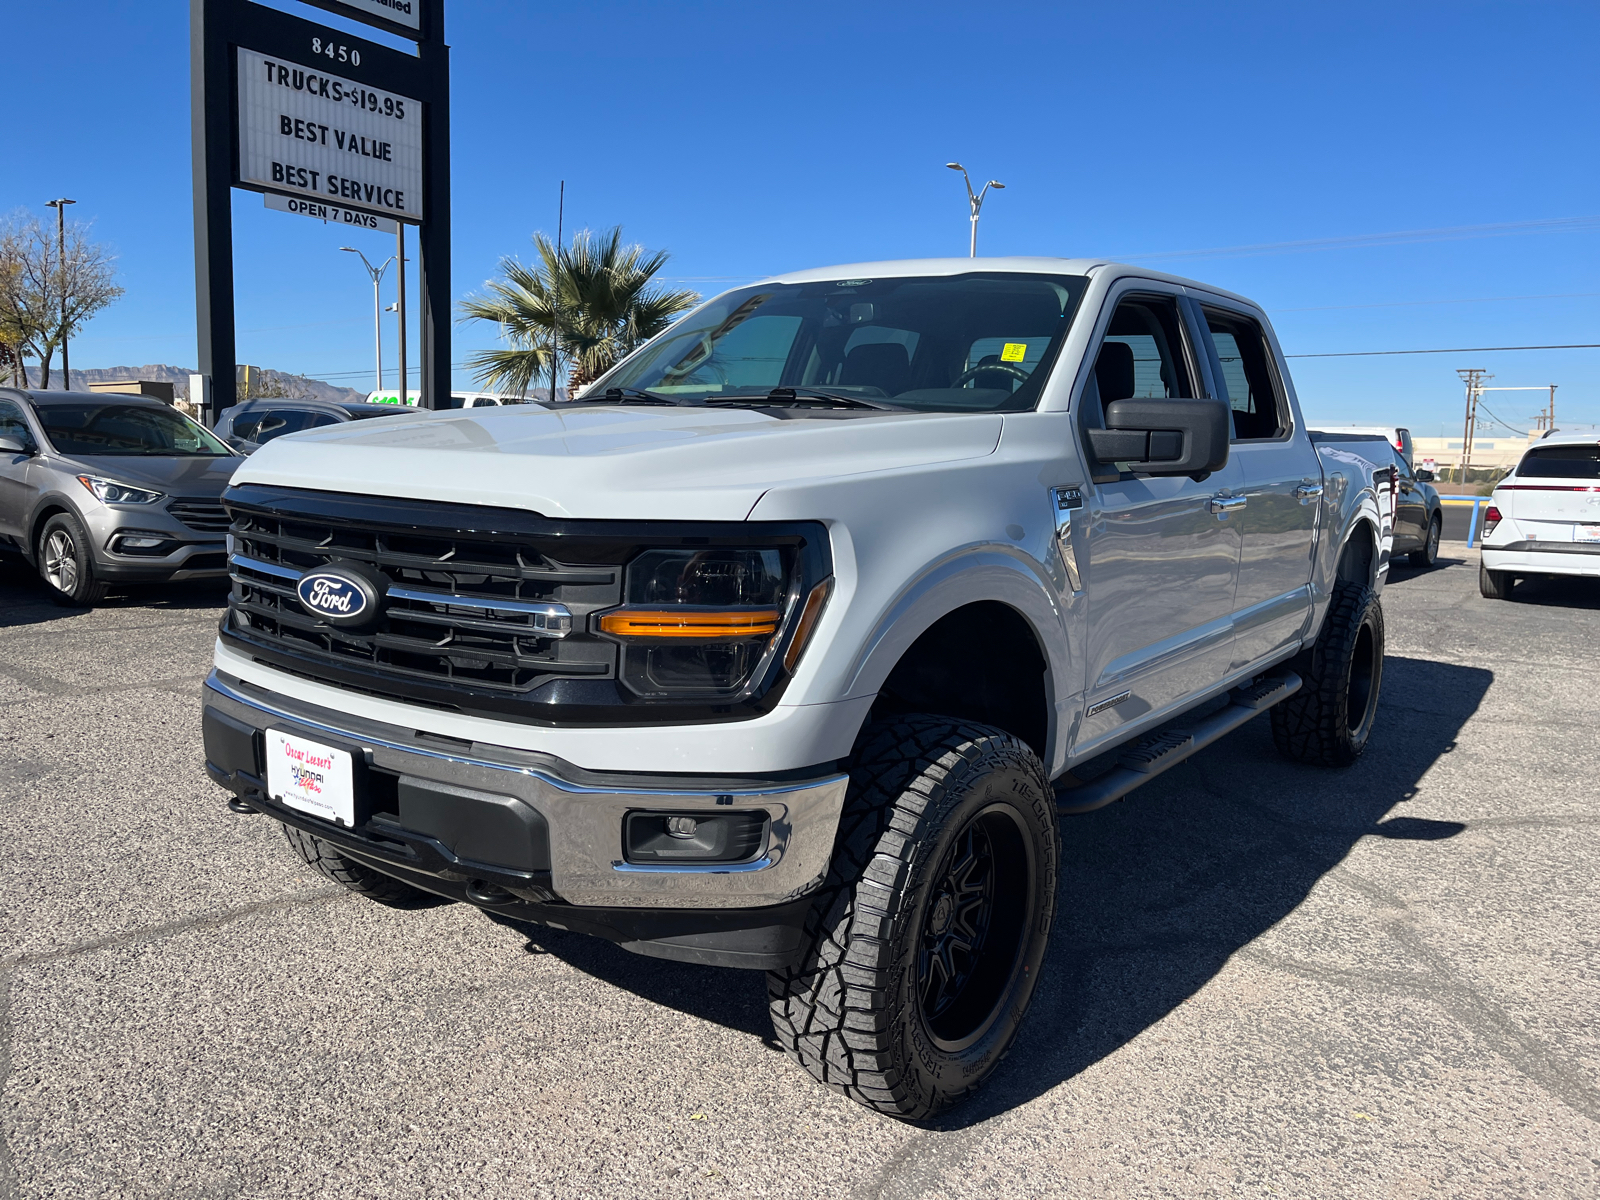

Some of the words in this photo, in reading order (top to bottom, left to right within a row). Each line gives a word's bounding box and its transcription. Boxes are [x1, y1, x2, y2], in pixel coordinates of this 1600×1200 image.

[311, 37, 361, 67] 8450
[263, 60, 405, 120] TRUCKS-$19.95
[280, 114, 329, 146] BEST
[334, 129, 392, 162] VALUE
[271, 161, 320, 191] BEST
[327, 175, 405, 210] SERVICE
[288, 199, 327, 219] OPEN
[331, 208, 339, 220] 7
[344, 211, 378, 229] DAYS
[309, 578, 352, 613] Ford
[285, 742, 305, 762] Oscar
[305, 750, 332, 770] Leeser's
[291, 764, 324, 783] HYUNDAI
